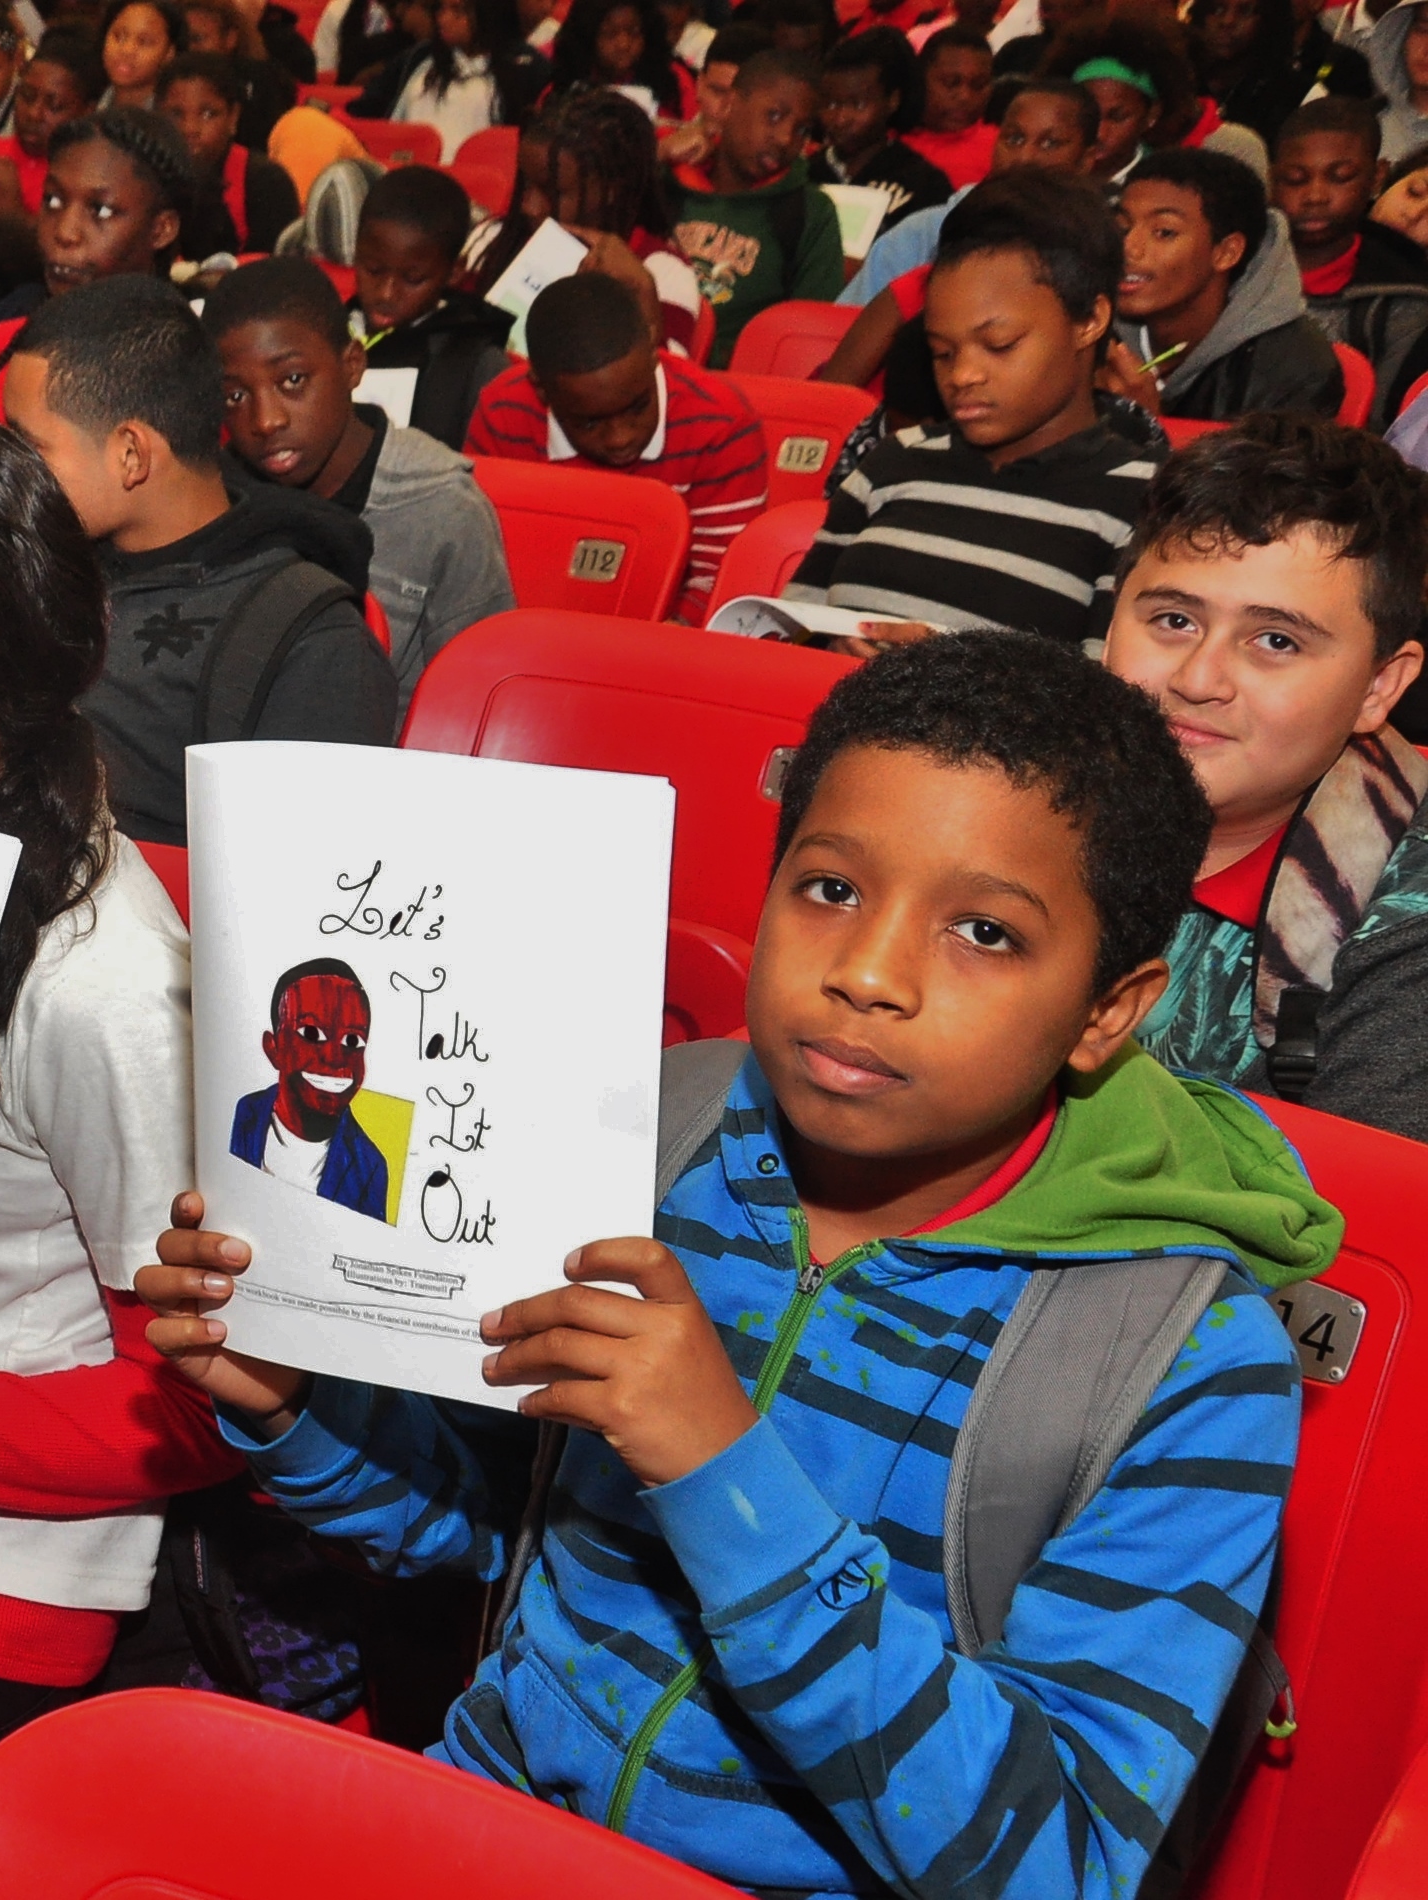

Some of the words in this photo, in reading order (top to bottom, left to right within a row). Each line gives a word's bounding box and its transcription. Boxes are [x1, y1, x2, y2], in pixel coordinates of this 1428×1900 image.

[785, 444, 821, 466] 112
[578, 547, 616, 574] 112
[318, 858, 446, 941] Let's
[389, 966, 490, 1063] Talk
[425, 1082, 493, 1153] It
[420, 1162, 497, 1246] Out
[336, 1258, 349, 1269] By
[349, 1260, 385, 1275] Jonathan
[386, 1265, 413, 1280] Spikes
[413, 1268, 460, 1286] Foundation
[346, 1270, 394, 1287] Illustrations
[245, 1286, 280, 1302] workbook
[282, 1296, 296, 1305] was
[297, 1298, 318, 1311] made
[319, 1302, 350, 1317] possible
[351, 1307, 361, 1319] by
[362, 1309, 376, 1321] the
[377, 1312, 411, 1328] financial
[412, 1319, 460, 1336] contribution
[461, 1326, 471, 1337] of
